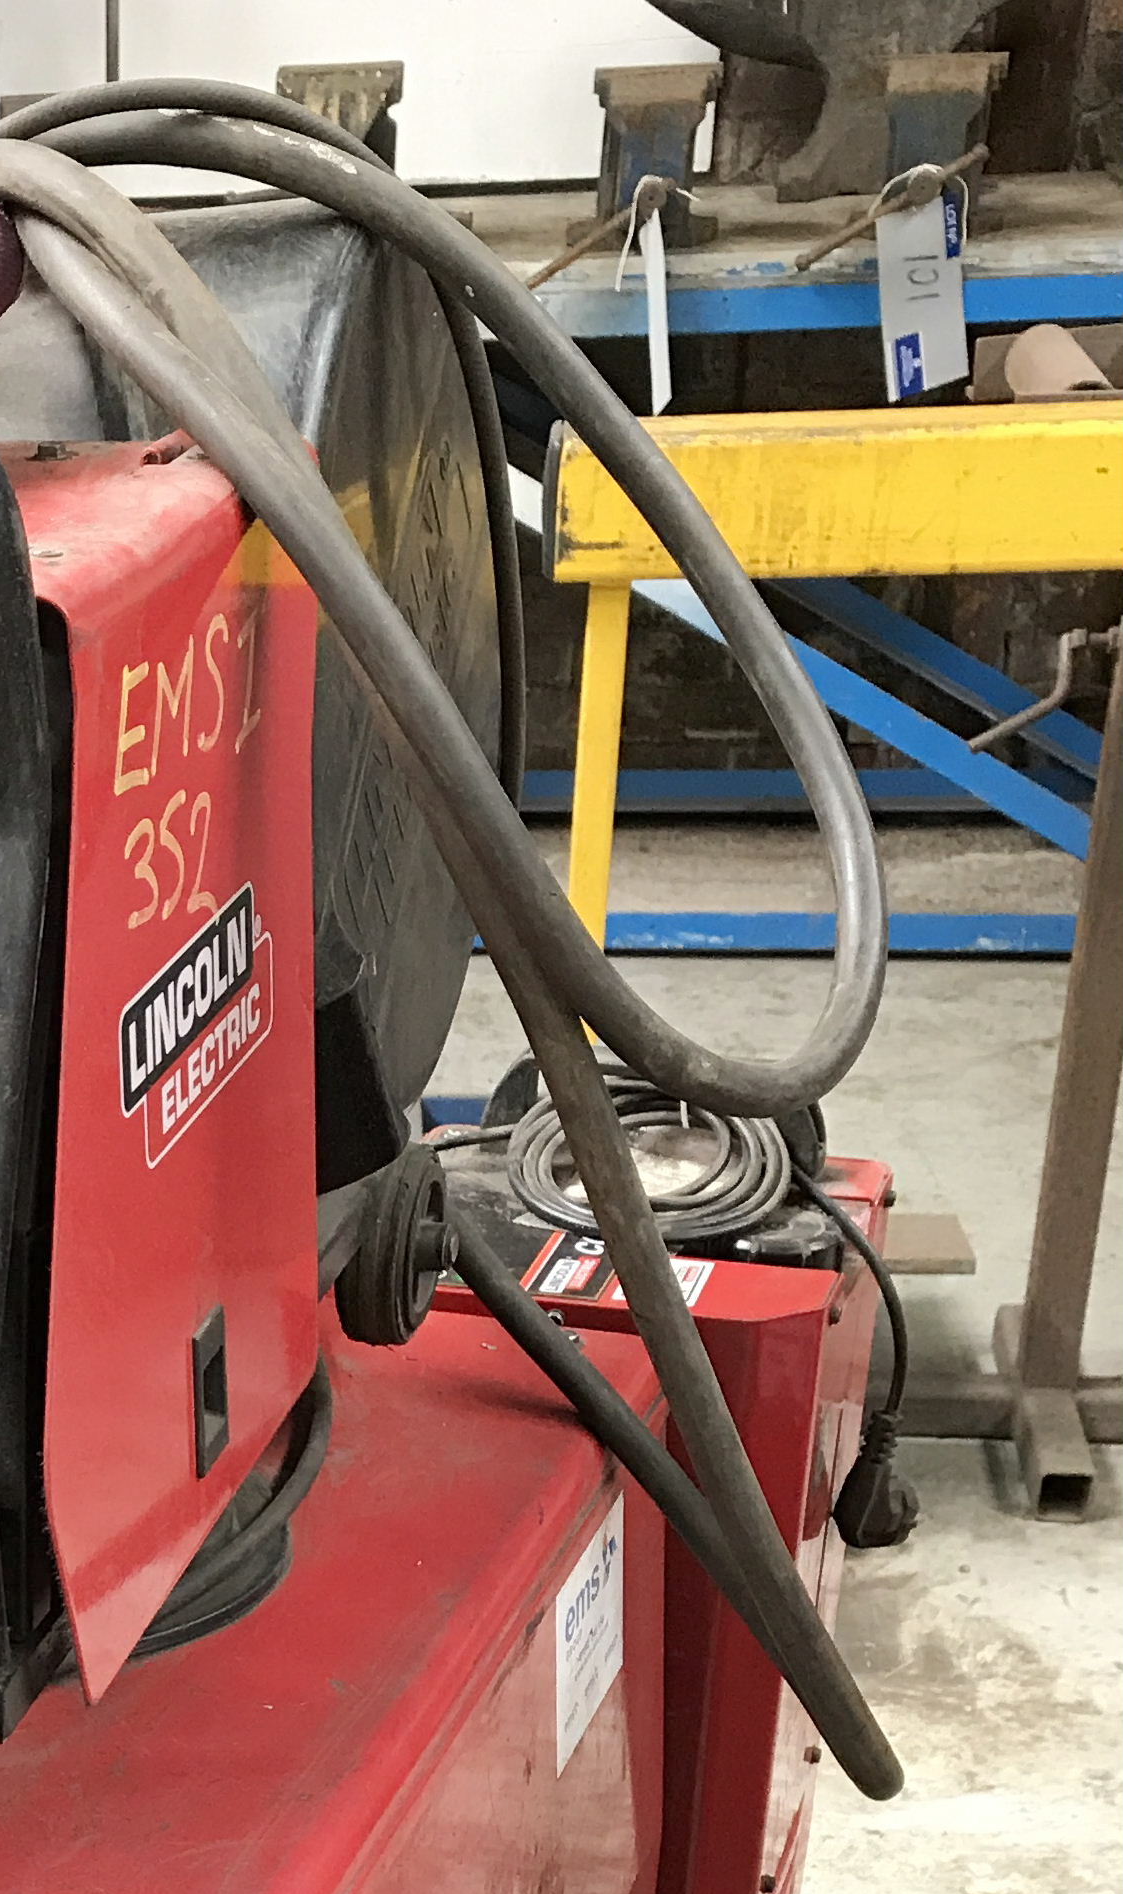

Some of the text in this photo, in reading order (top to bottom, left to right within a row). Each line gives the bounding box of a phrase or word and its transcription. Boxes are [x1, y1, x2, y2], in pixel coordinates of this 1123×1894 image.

[123, 790, 221, 931] 352
[128, 905, 250, 1093] LINCOLN
[161, 982, 262, 1136] ELECTRIC
[564, 1562, 600, 1644] ems
